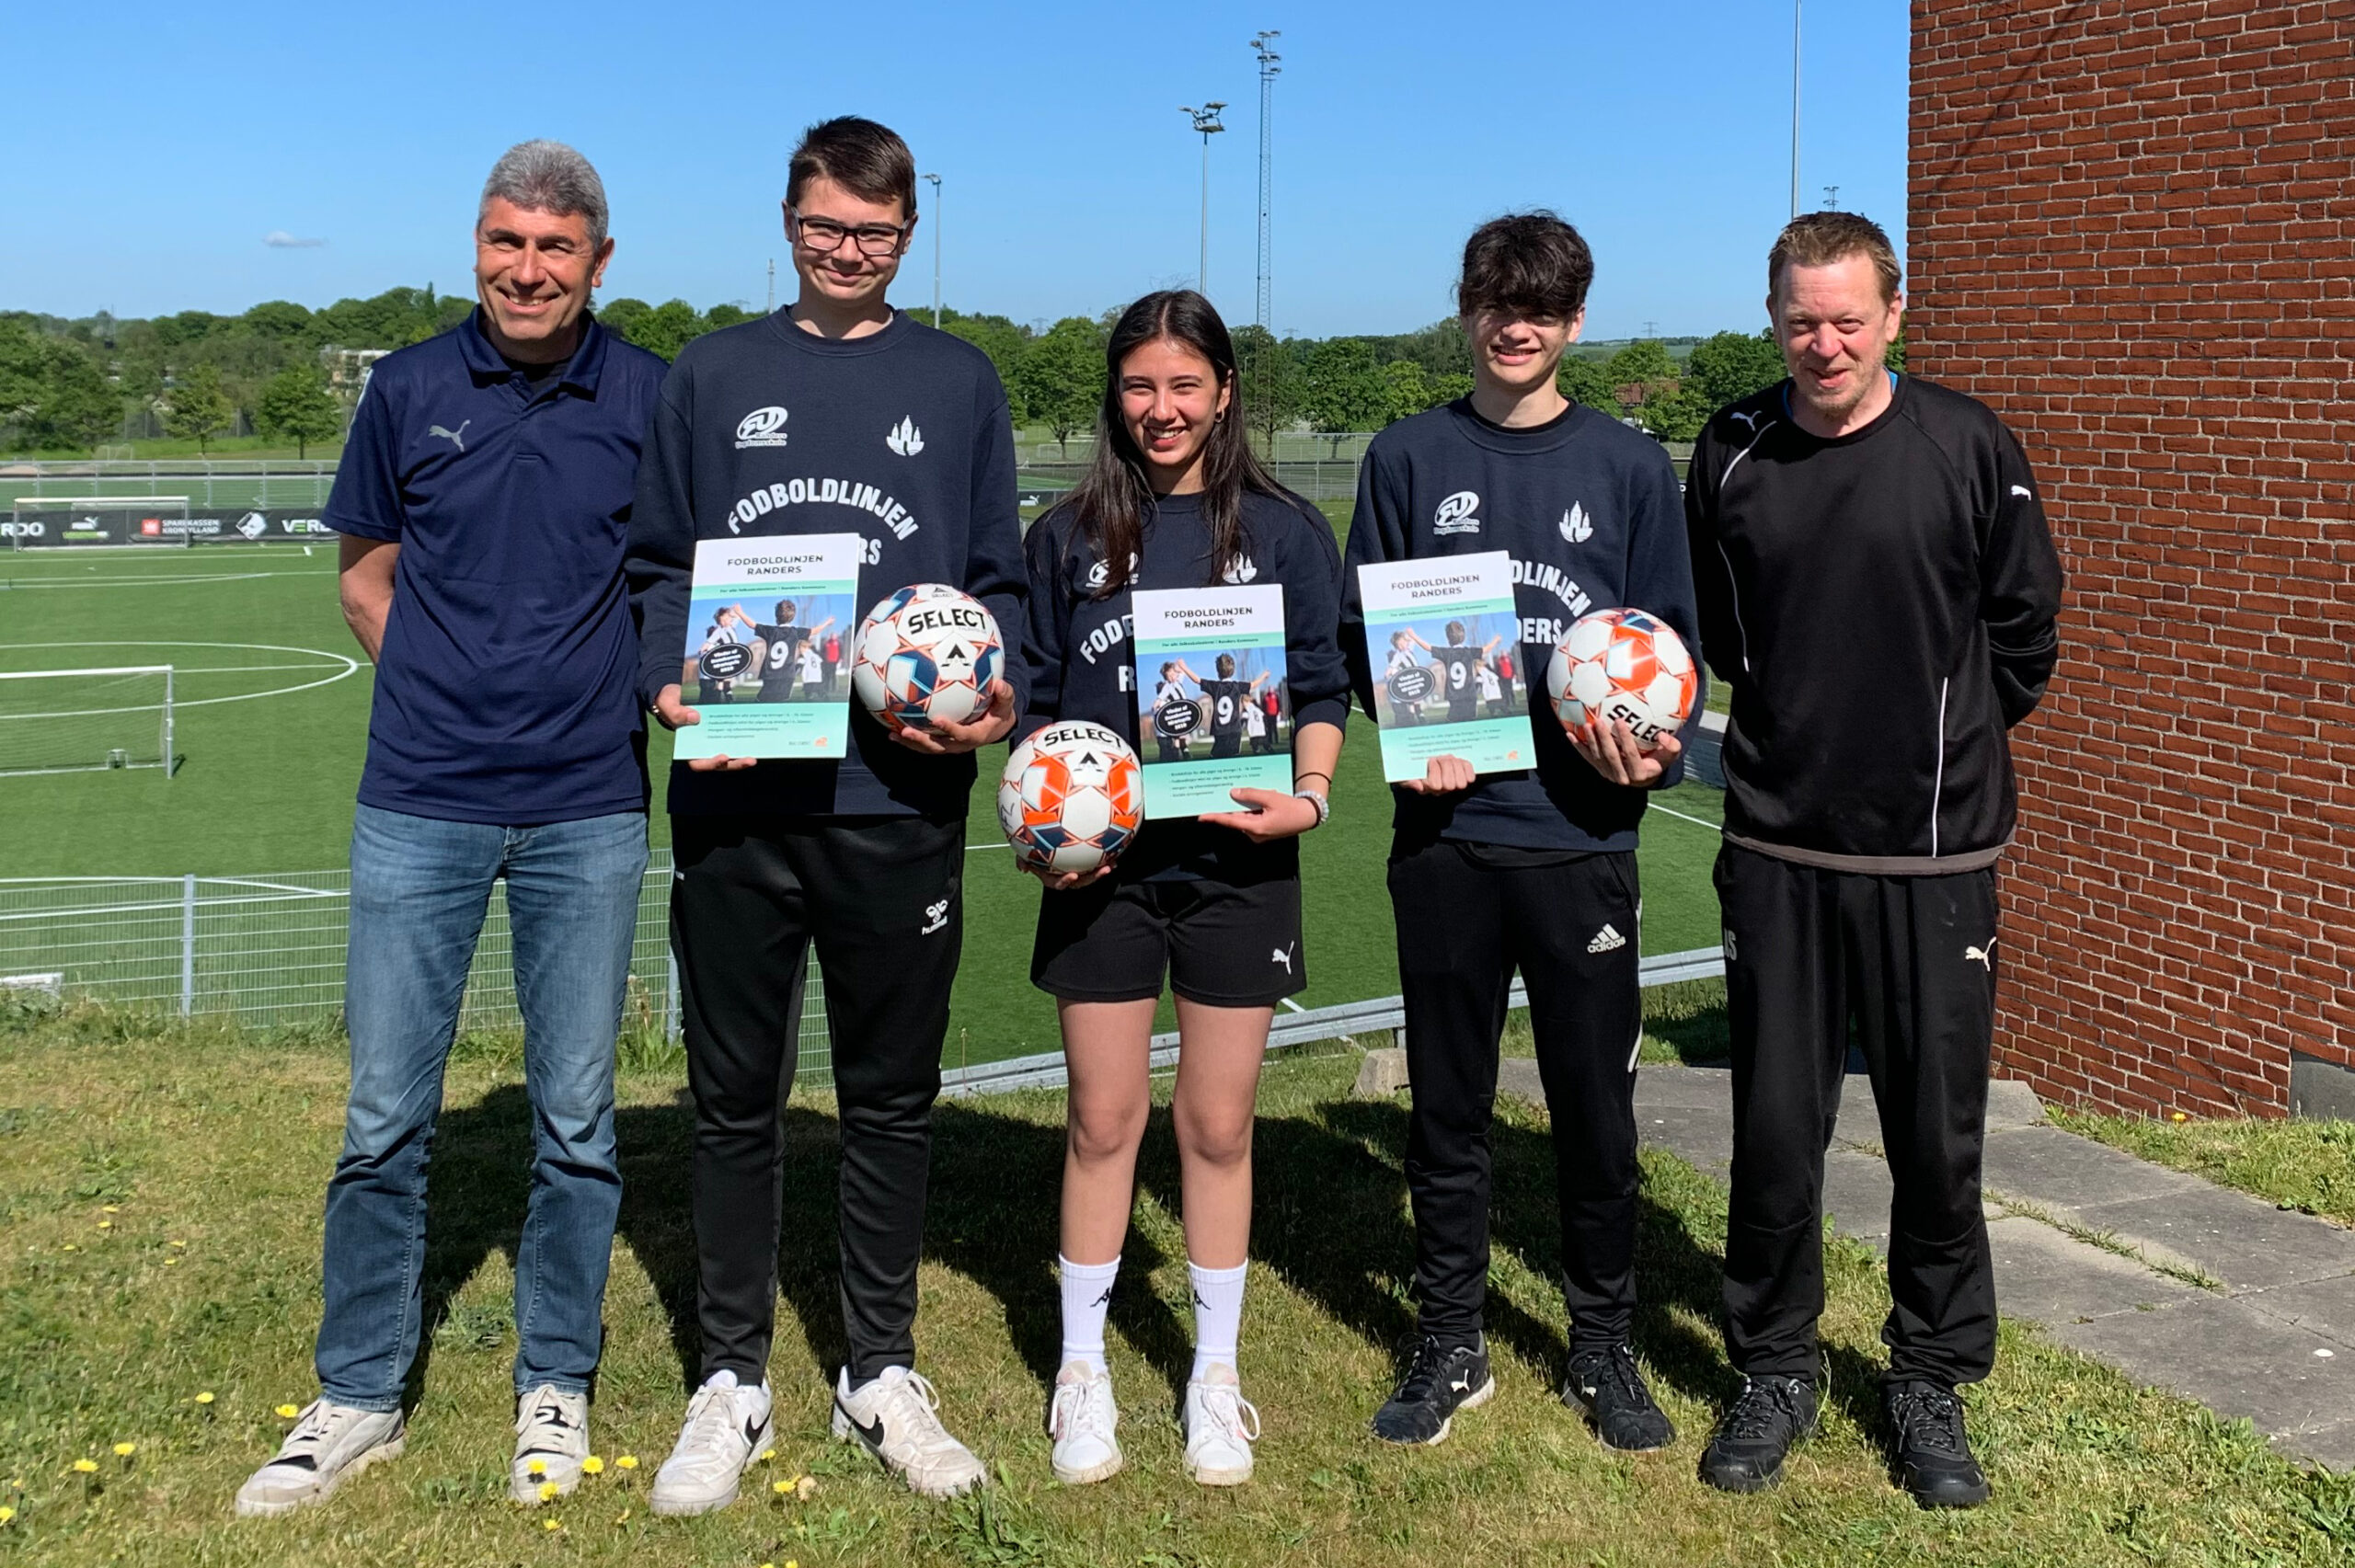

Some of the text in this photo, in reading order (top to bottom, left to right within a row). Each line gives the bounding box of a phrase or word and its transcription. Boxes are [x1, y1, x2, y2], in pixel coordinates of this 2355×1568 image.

[728, 477, 919, 541] FODBOLDLINJEN
[162, 519, 220, 527] SPARKASSEN
[728, 555, 823, 567] FODBOLDLINJEN
[747, 566, 802, 576] RANDERS
[1391, 574, 1479, 591] FODBOLDLINJEN
[1411, 587, 1463, 599] RANDERS
[1164, 606, 1253, 619] FODBOLDLINJEN
[908, 609, 985, 635] SELECT
[1185, 619, 1235, 629] RANDERS
[770, 641, 788, 670] 9
[1450, 661, 1466, 690] 9
[1217, 695, 1234, 725] 9
[1044, 728, 1120, 748] SELECT
[1587, 935, 1626, 953] adidas
